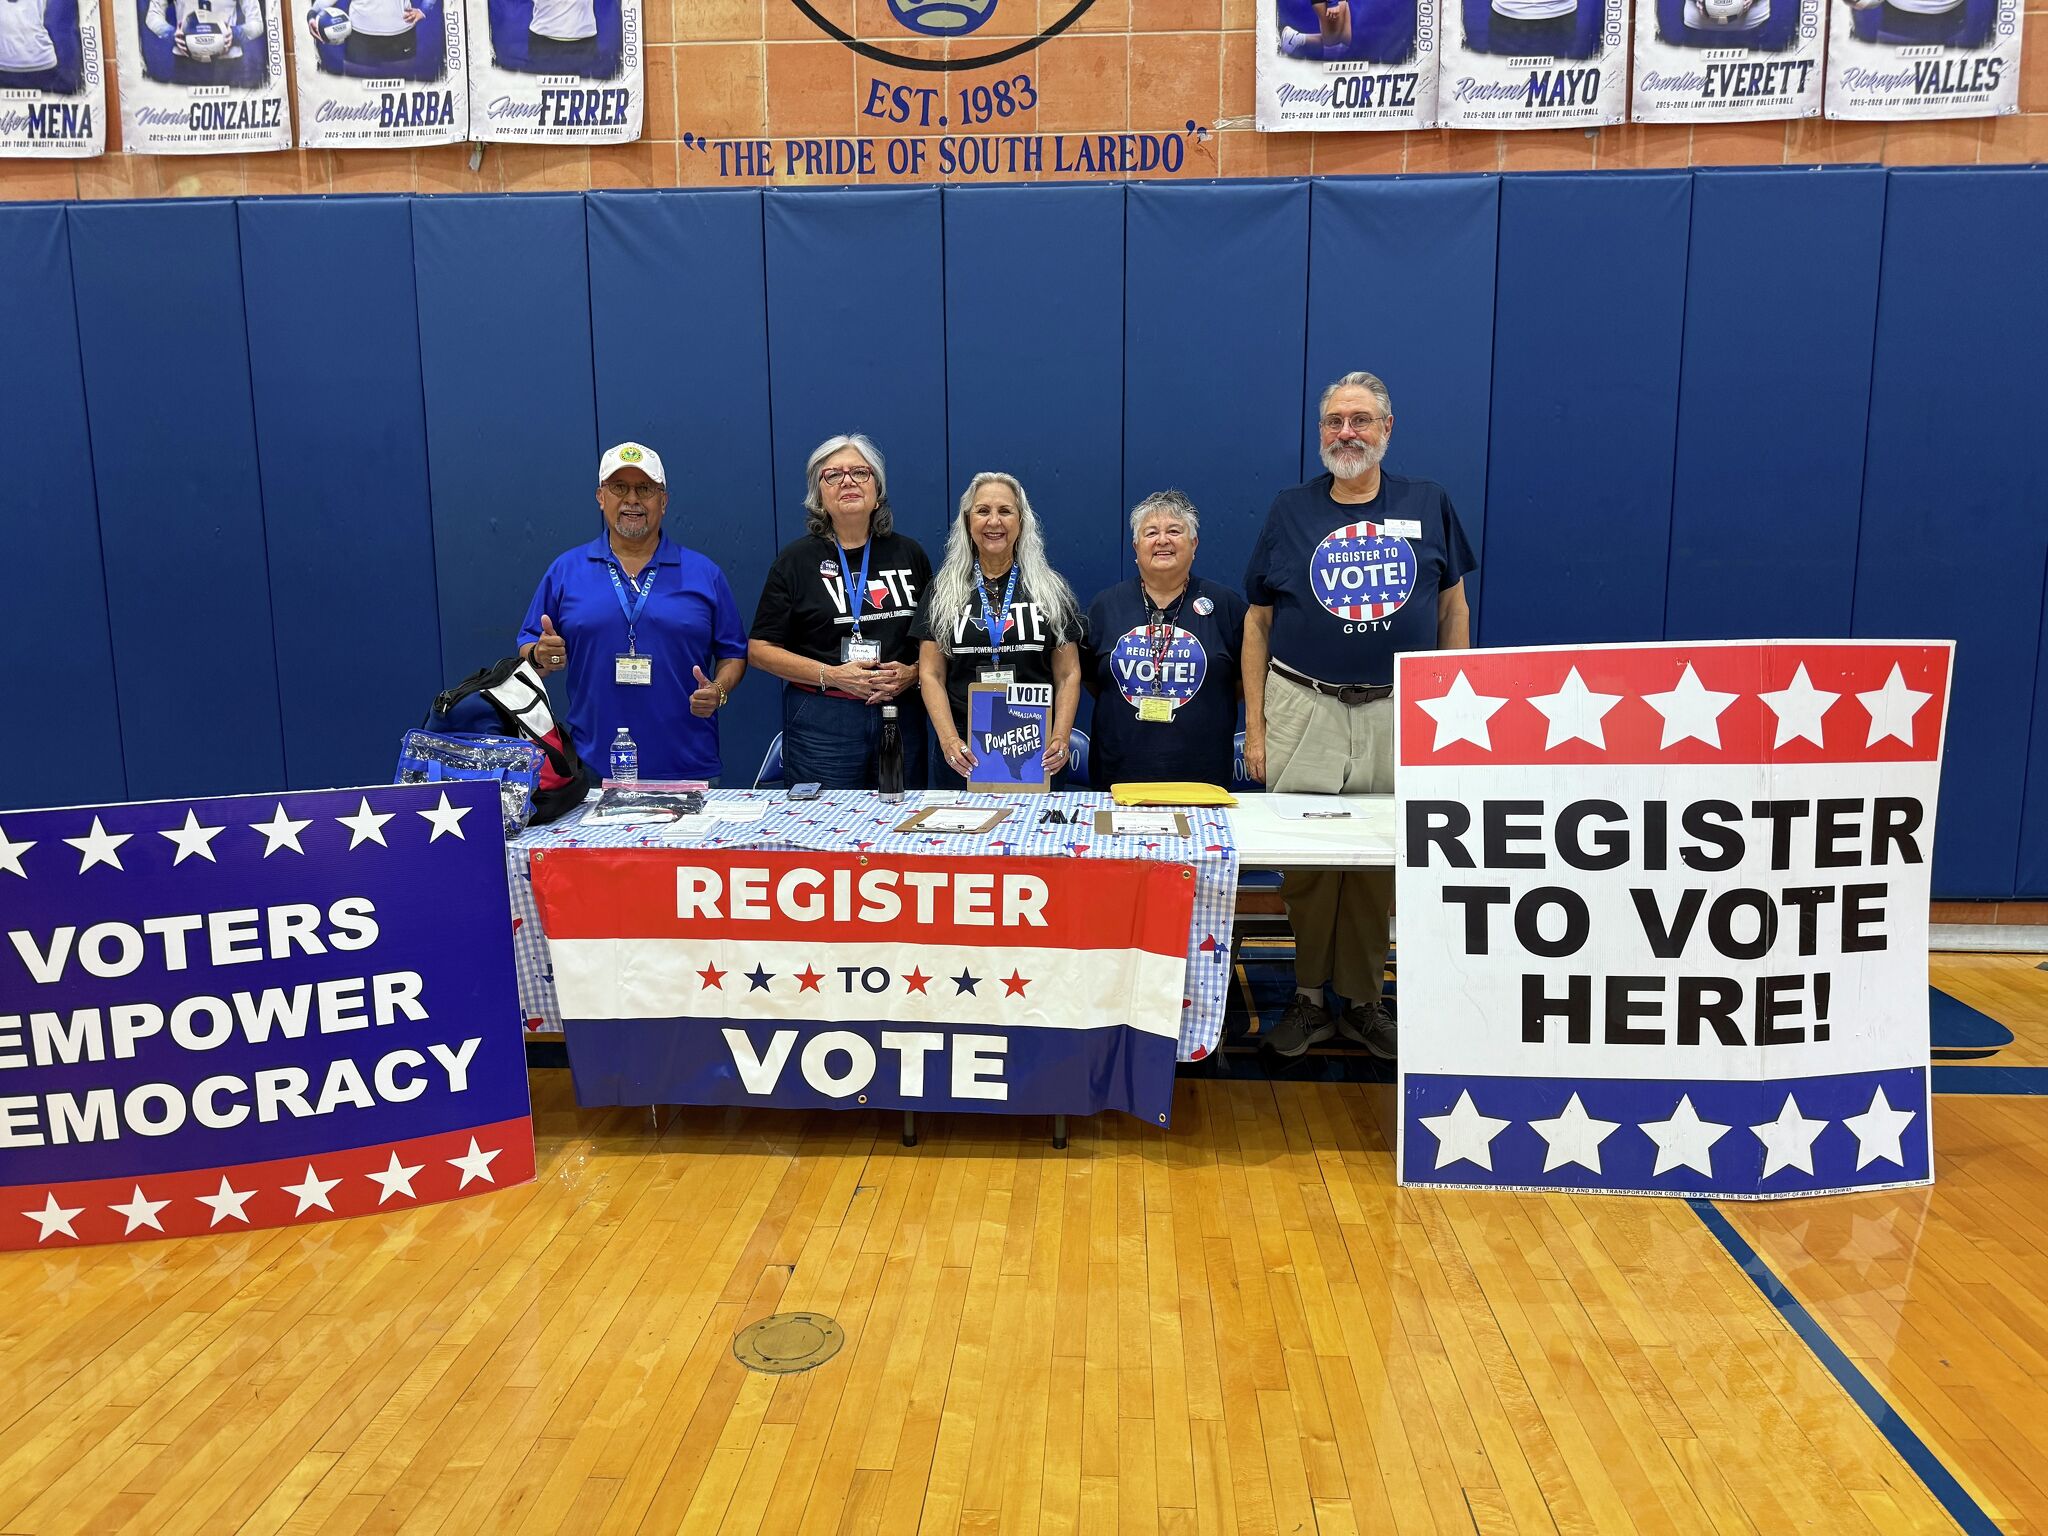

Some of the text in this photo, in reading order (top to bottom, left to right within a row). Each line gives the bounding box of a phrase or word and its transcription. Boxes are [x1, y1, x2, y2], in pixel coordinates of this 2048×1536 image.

[1419, 0, 1433, 51] OROS
[1606, 0, 1622, 46] OROS
[1800, 0, 1818, 38] ROS
[1999, 0, 2016, 35] ROS
[82, 25, 100, 86] TOROS
[267, 17, 282, 76] TOROS
[446, 11, 461, 70] TOROS
[624, 8, 637, 68] TOROS
[1707, 50, 1743, 59] SENIOR
[1329, 63, 1364, 72] JUNIOR
[1509, 57, 1552, 67] SOPHOMORE
[1701, 59, 1815, 98] EVERETT
[1914, 57, 2003, 95] VALLES
[193, 87, 225, 96] JUNIOR
[366, 80, 401, 88] FRESHMAN
[541, 77, 575, 85] JUNIOR
[1331, 73, 1419, 109] CORTEZ
[1525, 68, 1601, 108] MAYO
[189, 98, 281, 131] GONZALEZ
[379, 90, 454, 128] BARBA
[538, 88, 630, 126] FERRER
[862, 74, 1038, 127] EST. 1983
[27, 103, 93, 139] MENA
[416, 128, 448, 136] VOLLEYBALL
[591, 127, 623, 135] VOLLEYBALL
[785, 139, 876, 176] PRIDE
[887, 138, 927, 175] OF
[938, 136, 1043, 175] SOUTH
[1327, 547, 1398, 564] REGISTER TO
[1320, 561, 1407, 591] VOTE!
[1343, 620, 1392, 634] GOTV
[1118, 658, 1196, 683] VOTE!
[1178, 649, 1191, 659] TO
[1008, 686, 1049, 703] I VOTE
[985, 724, 1039, 753] POWERED
[1002, 738, 1041, 758] BY PEOPLE
[1405, 796, 1924, 872] REGISTER
[676, 866, 1050, 928] REGISTER
[1442, 882, 1888, 960] TO VOTE
[8, 897, 380, 984] VOTERS
[837, 966, 890, 994] TO
[1521, 972, 1831, 1047] HERE!
[722, 1028, 1009, 1101] VOTE
[0, 1037, 483, 1149] EMOCRACY
